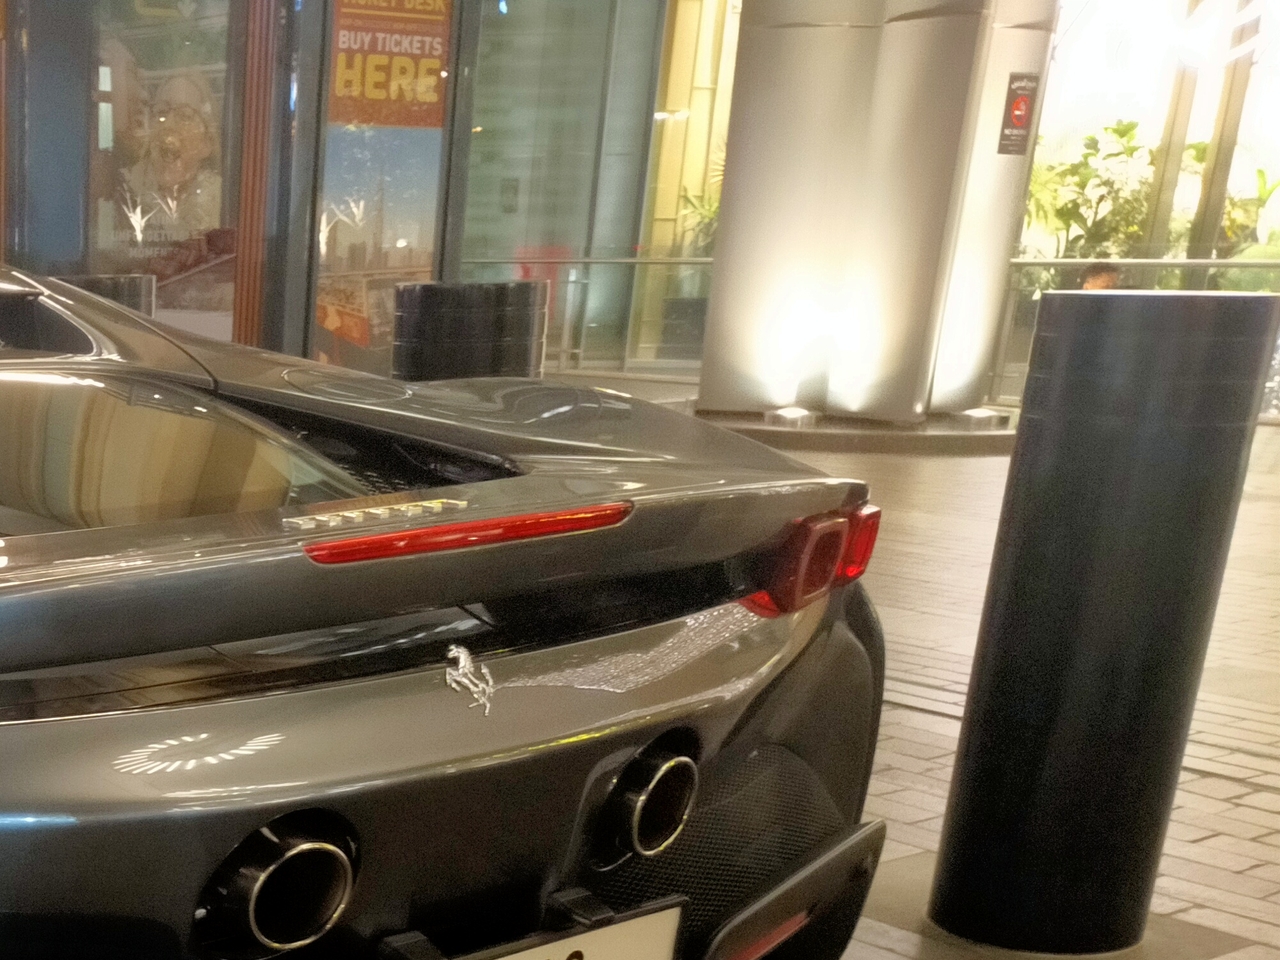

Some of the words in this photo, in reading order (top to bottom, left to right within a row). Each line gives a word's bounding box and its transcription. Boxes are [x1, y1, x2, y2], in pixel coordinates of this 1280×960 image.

[338, 29, 372, 51] BUY
[375, 32, 443, 56] TICKETS
[335, 52, 441, 103] HERE
